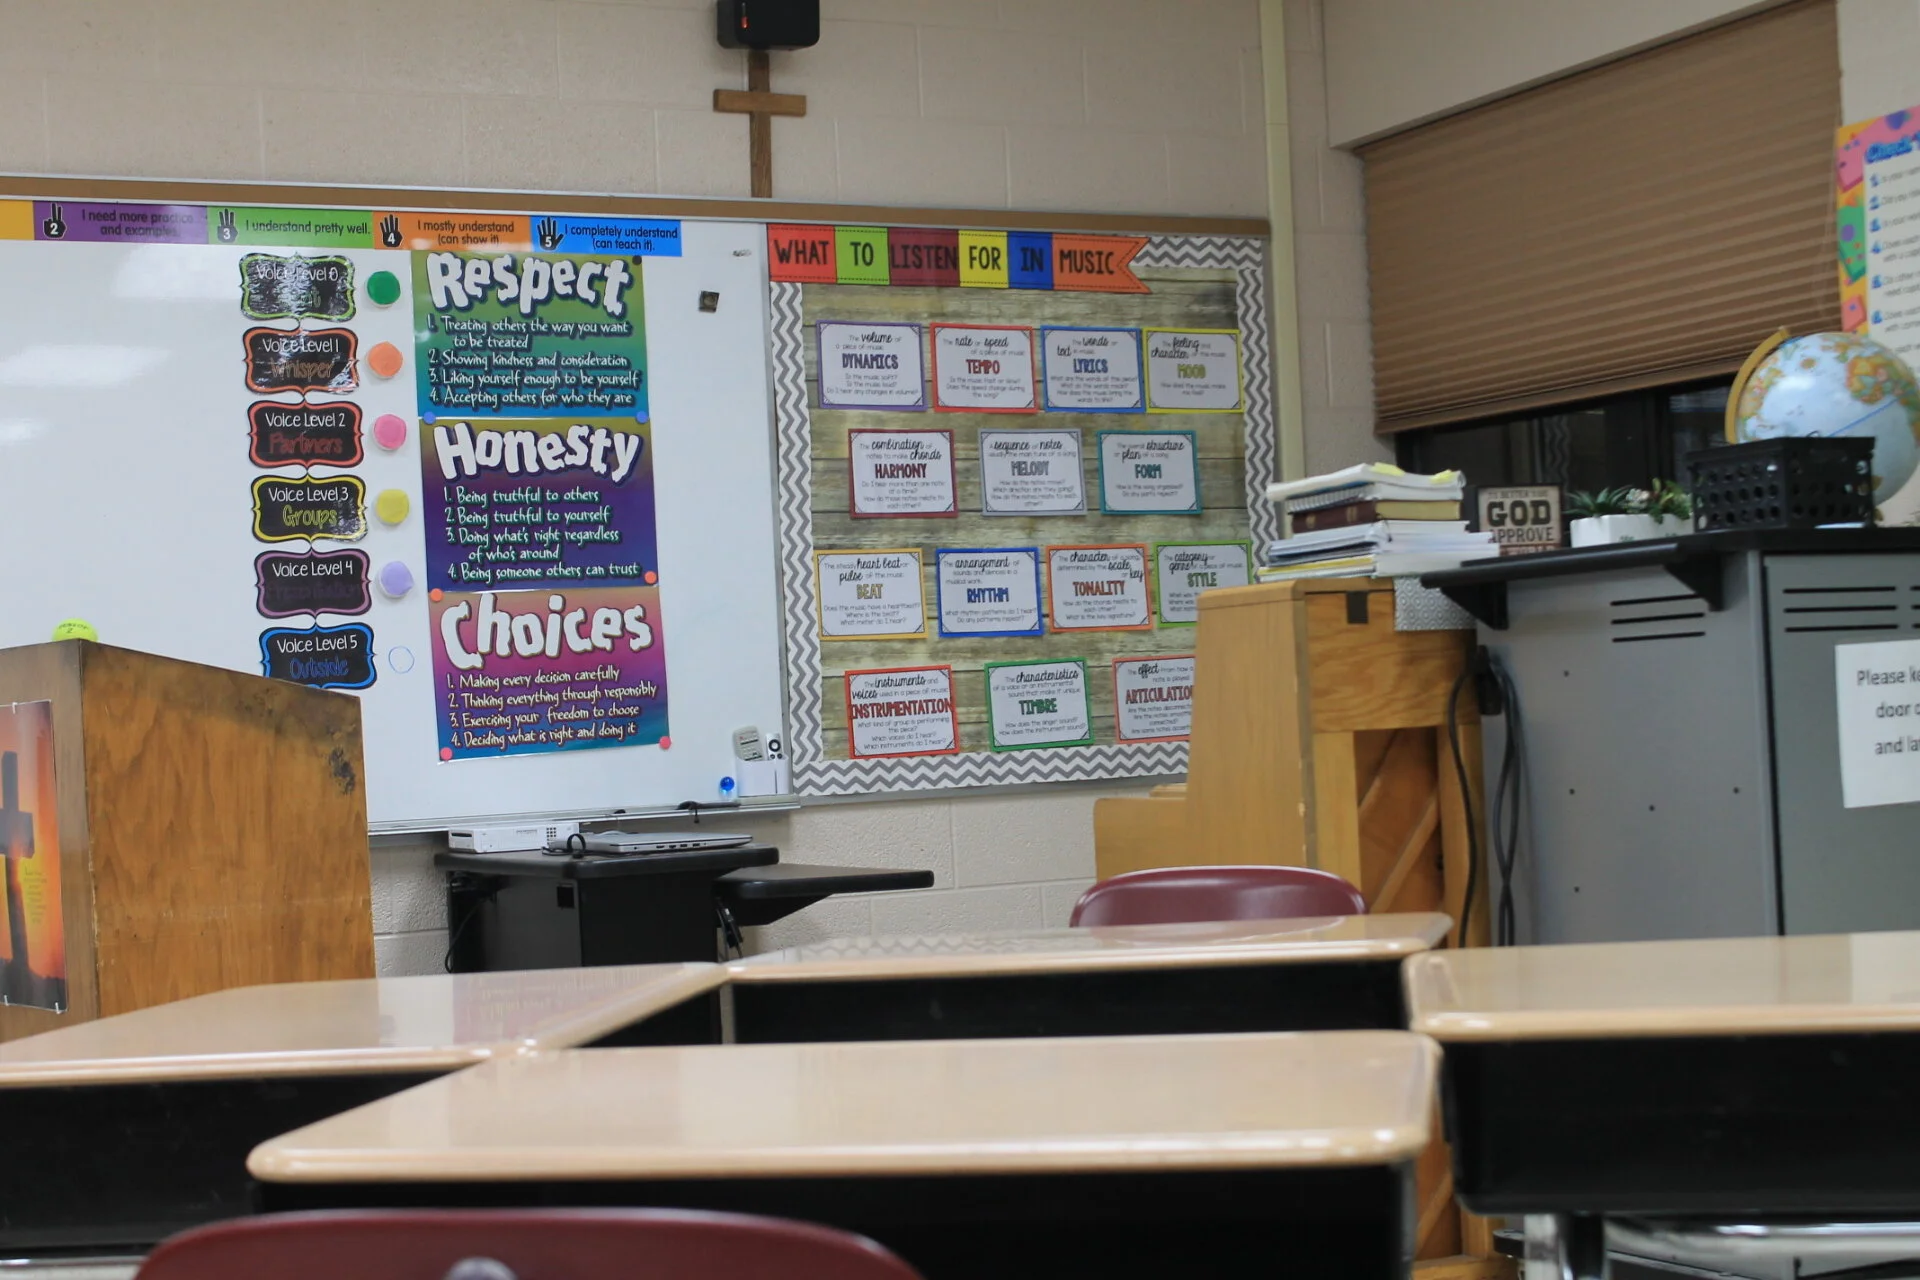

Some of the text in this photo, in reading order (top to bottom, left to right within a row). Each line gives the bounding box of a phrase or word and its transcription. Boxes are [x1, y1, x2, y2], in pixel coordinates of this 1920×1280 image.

[88, 210, 194, 225] need more practice
[50, 223, 58, 234] 2
[101, 224, 122, 235] and
[223, 228, 231, 240] 3
[252, 220, 371, 236] understand pretty well.
[423, 220, 514, 233] mostly understand
[571, 225, 678, 240] completely understand
[388, 232, 396, 244] 4
[438, 234, 487, 246] (can show
[545, 236, 552, 248] 5
[592, 237, 640, 250] (can teach
[774, 240, 1115, 276] WHAT TO LISTEN FOR IN MUSIC
[426, 252, 628, 316] Respect
[441, 315, 629, 338] Treating others the way you want
[262, 338, 334, 352] Voice Level
[454, 334, 529, 348] to be treated
[861, 332, 892, 343] volume
[442, 350, 628, 370] Showing kindness and consideration
[842, 353, 898, 370] DYNAMICS
[966, 359, 1000, 374] TEMPO
[1074, 358, 1108, 374] LYRICS
[270, 358, 334, 382] Whisper
[442, 370, 640, 390] Liking yourself enough to be yourself
[444, 388, 632, 409] Accepting others for who they are
[266, 412, 346, 427] Voice Level 2
[270, 432, 342, 454] Partners
[872, 438, 924, 450] combination
[434, 422, 640, 482] Honesty
[1122, 448, 1141, 464] plan
[875, 463, 927, 478] HARMONY
[1011, 460, 1049, 476] MELODY
[1135, 464, 1162, 479] FORM
[268, 487, 348, 502] Voice Level 3
[456, 485, 599, 508] Being truthful to others
[282, 504, 338, 529] Groups
[458, 506, 610, 528] Being truthful to yourself
[1487, 500, 1551, 527] GOD
[459, 526, 619, 548] Doing what's right regardless
[468, 544, 560, 563] of who's around
[1070, 552, 1110, 562] character
[272, 560, 353, 577] Voice Level 4
[857, 557, 900, 570] heart beat
[955, 556, 1010, 572] arrangement
[461, 562, 640, 584] Being someone others can trust
[840, 570, 863, 586] pulse
[1187, 572, 1218, 588] STYLE
[856, 584, 884, 600] BEAT
[966, 588, 1010, 604] RHYTHM
[1072, 580, 1126, 596] TONALITY
[441, 592, 652, 669] Choices
[277, 634, 358, 654] Voice Level 5
[290, 656, 349, 679] Outside
[1016, 668, 1079, 683] characteristics
[1138, 664, 1160, 678] effect
[460, 665, 620, 692] Making every decision carefully
[875, 674, 926, 688] instruments
[1856, 670, 1906, 686] Please
[461, 681, 658, 710] Thinking everything through responsibly
[852, 688, 878, 700] voices
[852, 698, 952, 720] INSTRUMENTATION
[1018, 698, 1058, 715] TIMBRE
[1876, 702, 1910, 718] door
[462, 703, 640, 730] Exercising your freedom to choose
[464, 722, 636, 750] Deciding what is right and doing it
[1875, 737, 1904, 754] and
